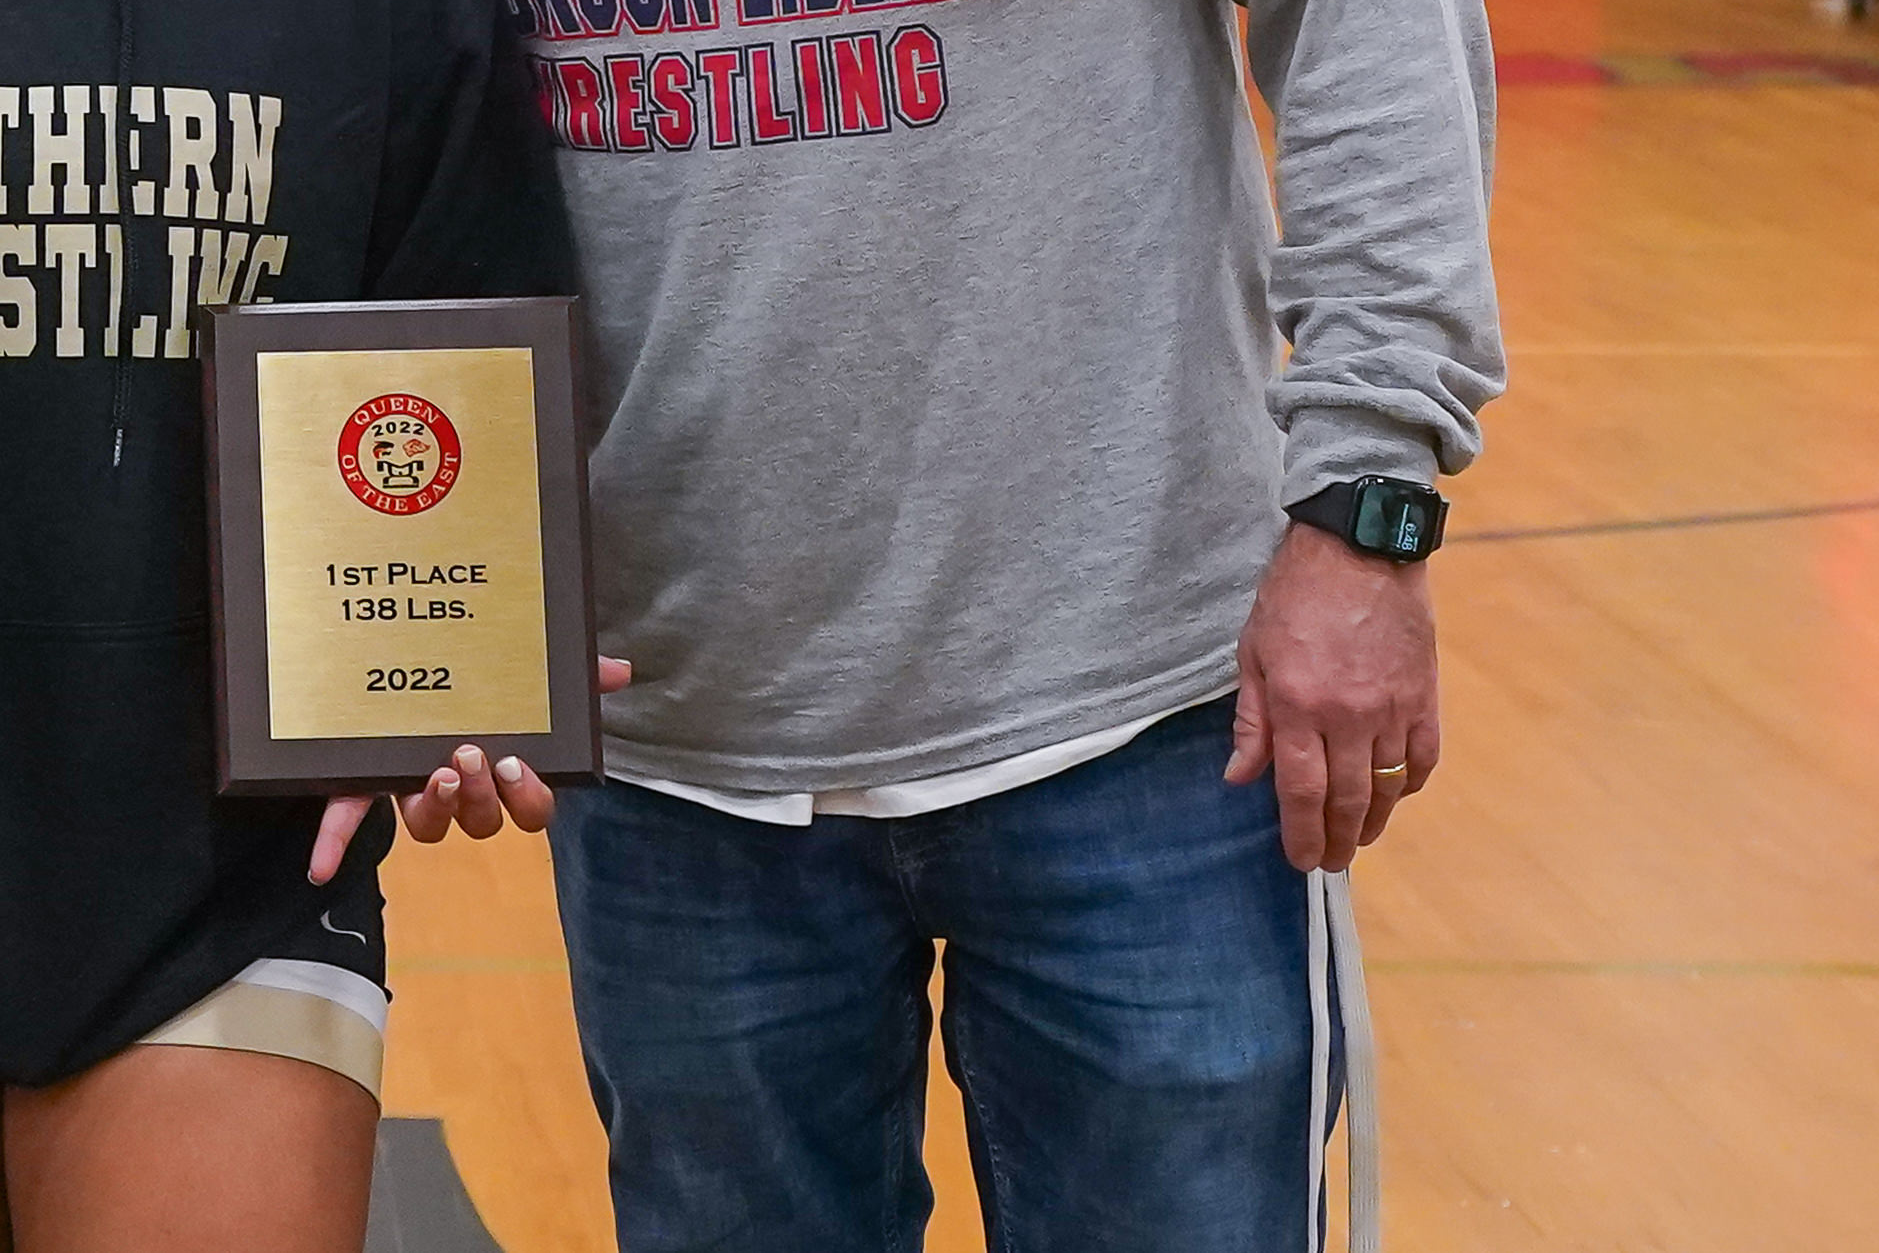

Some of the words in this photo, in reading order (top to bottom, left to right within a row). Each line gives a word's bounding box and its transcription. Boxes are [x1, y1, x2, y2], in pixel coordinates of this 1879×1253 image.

[527, 24, 950, 153] RESTLING
[354, 397, 440, 425] QUEEN
[372, 421, 425, 437] 2022
[342, 454, 362, 482] OF
[362, 485, 409, 512] THE
[416, 452, 458, 509] EAST
[326, 564, 378, 586] 1ST
[388, 563, 488, 585] PLACE
[342, 599, 398, 621] 138
[366, 667, 452, 692] 2022
